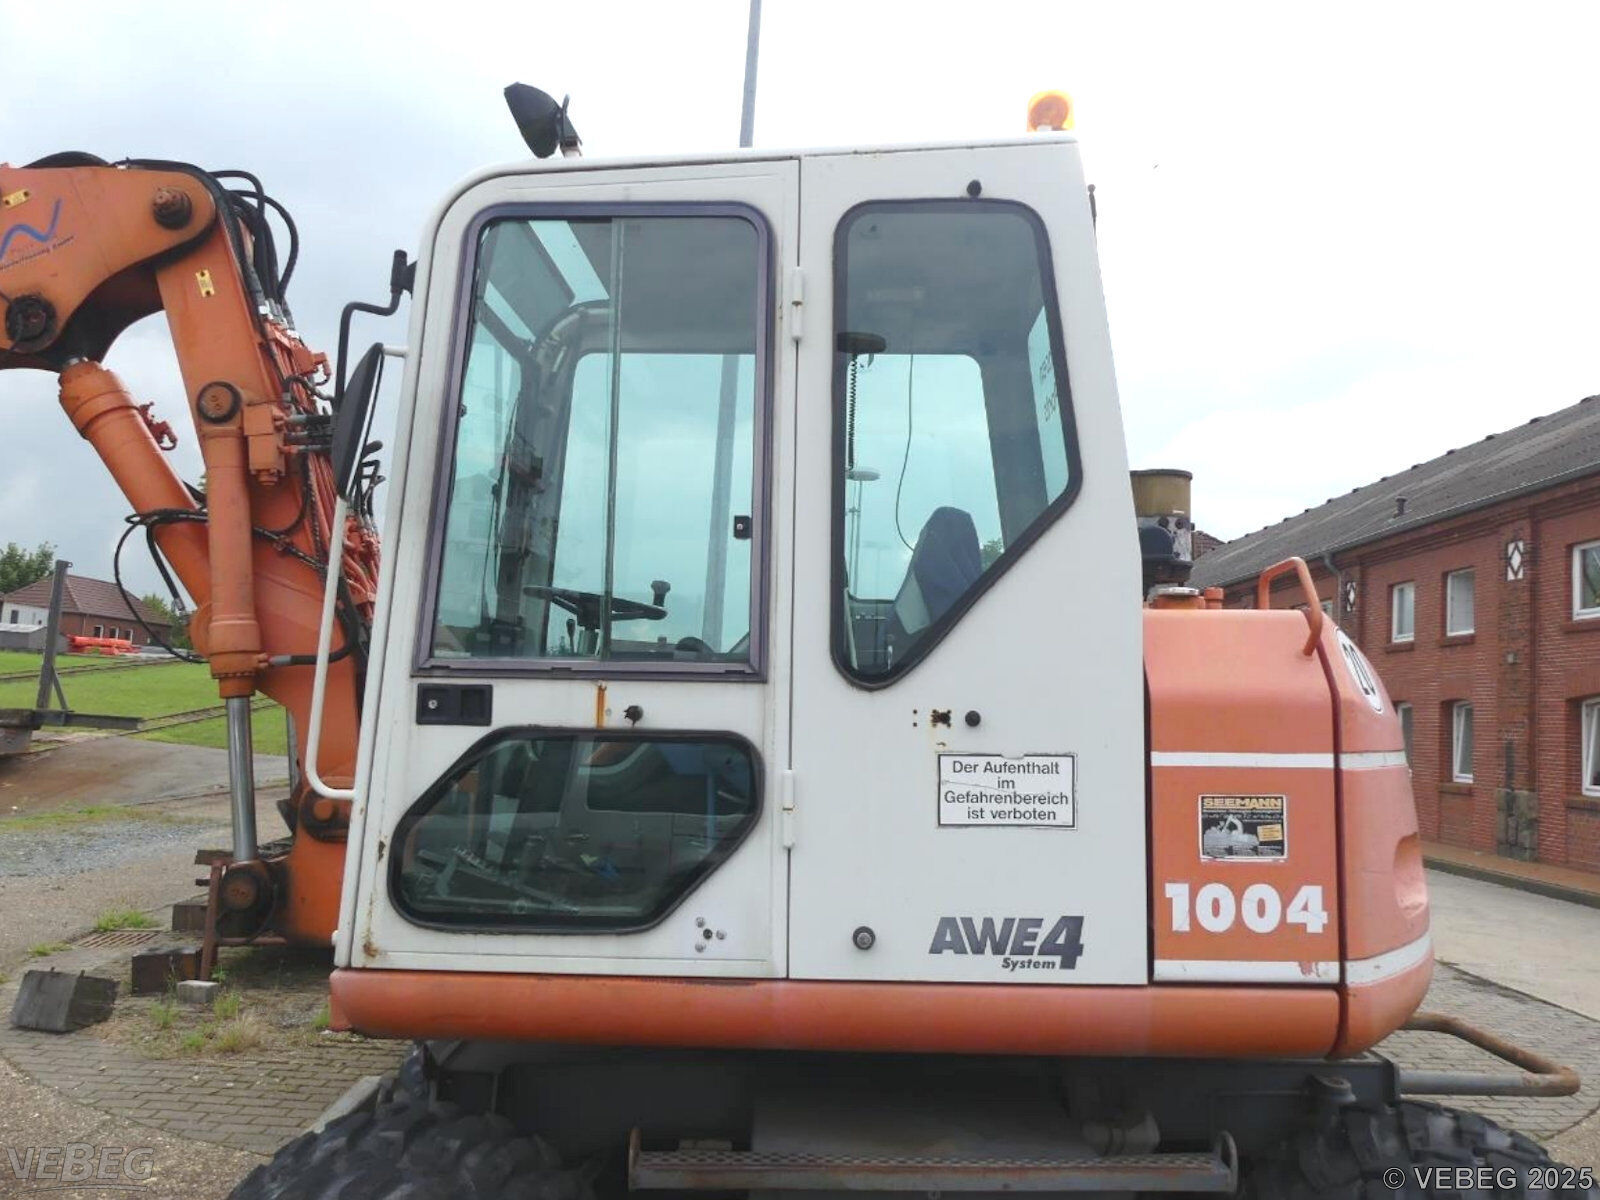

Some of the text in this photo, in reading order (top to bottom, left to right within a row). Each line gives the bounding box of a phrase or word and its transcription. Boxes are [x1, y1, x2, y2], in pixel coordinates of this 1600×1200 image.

[952, 760, 1060, 775] Der Aufenthalt
[997, 776, 1016, 789] im
[944, 790, 1069, 805] Gefahrenbereich
[1203, 798, 1283, 810] SEEMANN
[967, 807, 1057, 820] ist verboten
[1165, 883, 1328, 934] 1004
[1002, 957, 1056, 972] System
